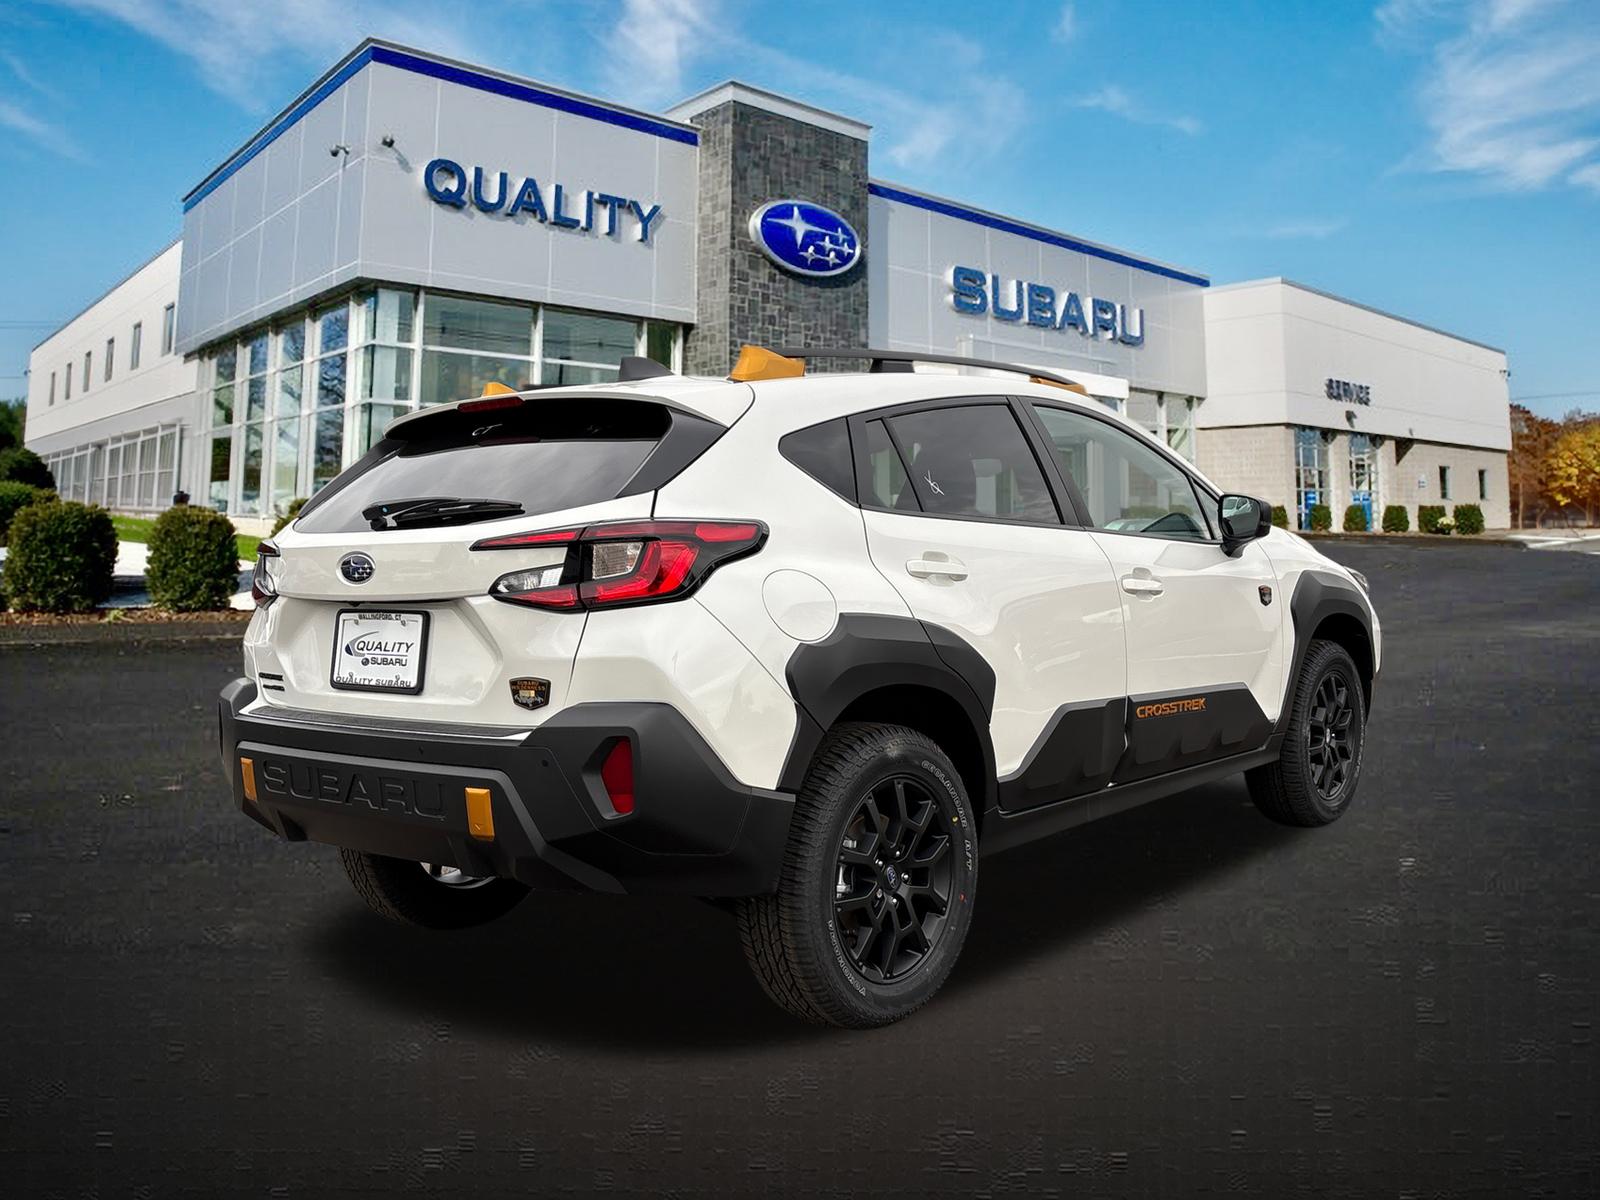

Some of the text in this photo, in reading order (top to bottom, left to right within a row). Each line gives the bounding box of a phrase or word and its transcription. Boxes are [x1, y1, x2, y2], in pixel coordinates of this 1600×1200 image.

[423, 157, 662, 244] QUALITY
[947, 264, 1145, 348] SUBARU
[1325, 377, 1371, 407] SERVICE
[356, 640, 414, 653] QUALITY
[370, 656, 408, 667] SUBARU
[335, 675, 412, 688] QUALITY SUBARU
[1136, 697, 1207, 719] CROSSTREK
[263, 759, 448, 822] SUBARU
